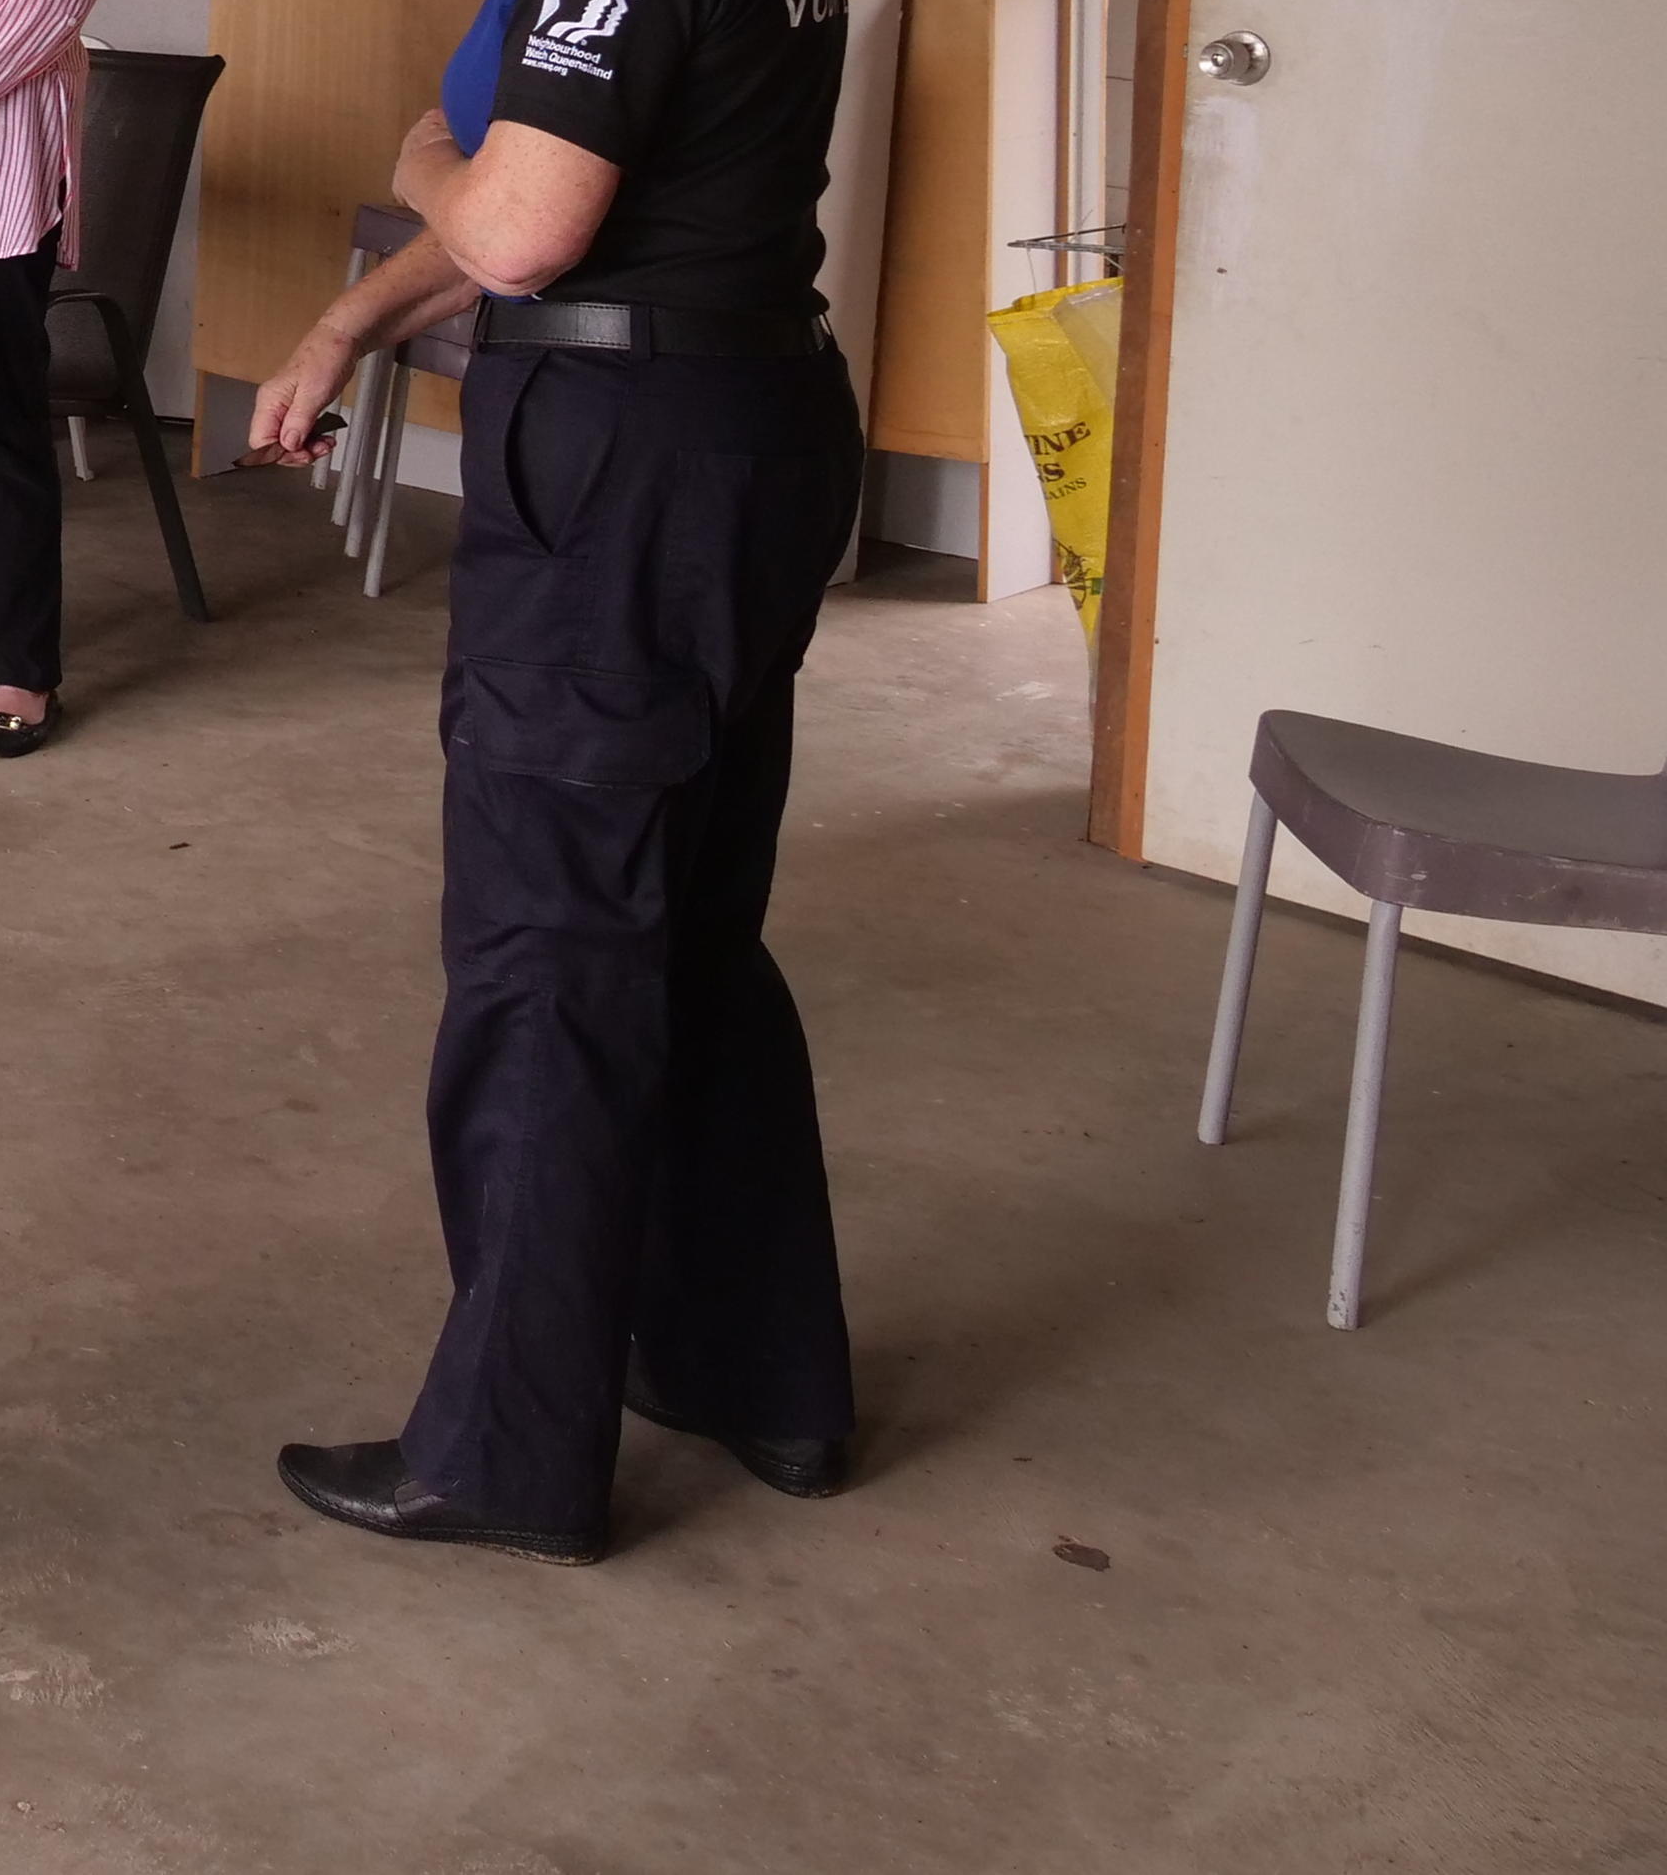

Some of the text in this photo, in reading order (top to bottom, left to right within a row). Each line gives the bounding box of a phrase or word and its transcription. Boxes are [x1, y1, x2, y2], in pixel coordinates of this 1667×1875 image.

[525, 45, 613, 81] Watch Queensland
[527, 34, 602, 64] Neighbourhood
[1024, 421, 1091, 456] INE
